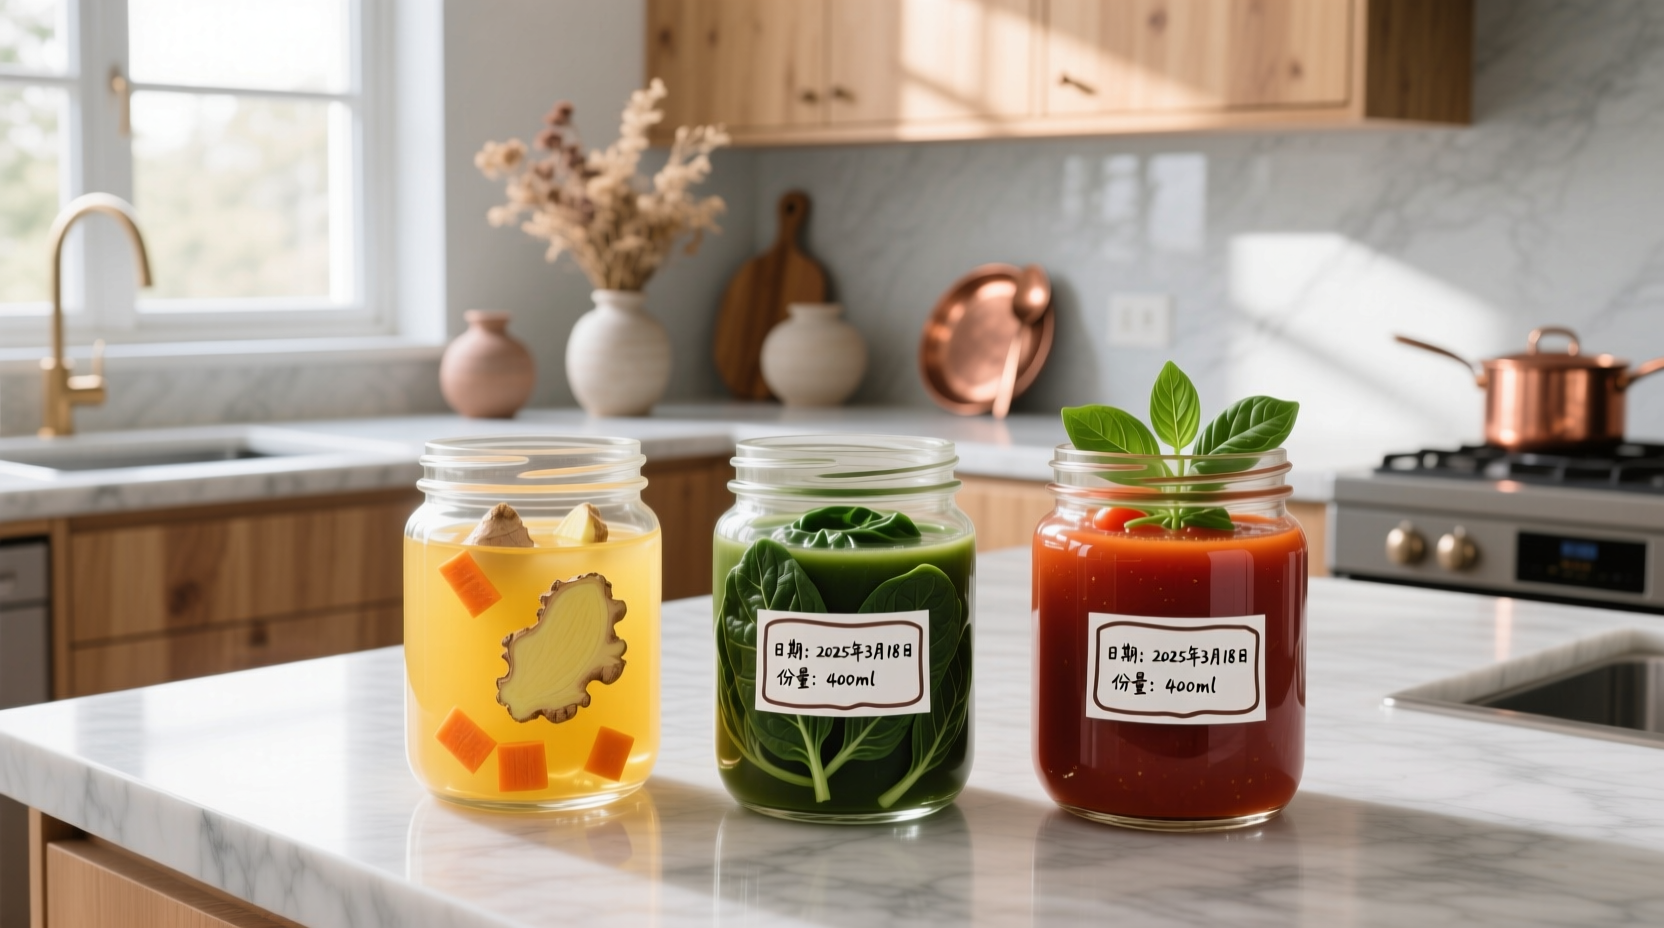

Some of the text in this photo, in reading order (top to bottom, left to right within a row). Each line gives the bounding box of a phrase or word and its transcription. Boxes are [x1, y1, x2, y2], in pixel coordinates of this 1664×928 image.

[816, 641, 912, 662] 2025年3月18日
[1152, 645, 1248, 667] 2025年3月18日
[826, 670, 875, 687] 400ml
[1165, 676, 1216, 694] 400ml
